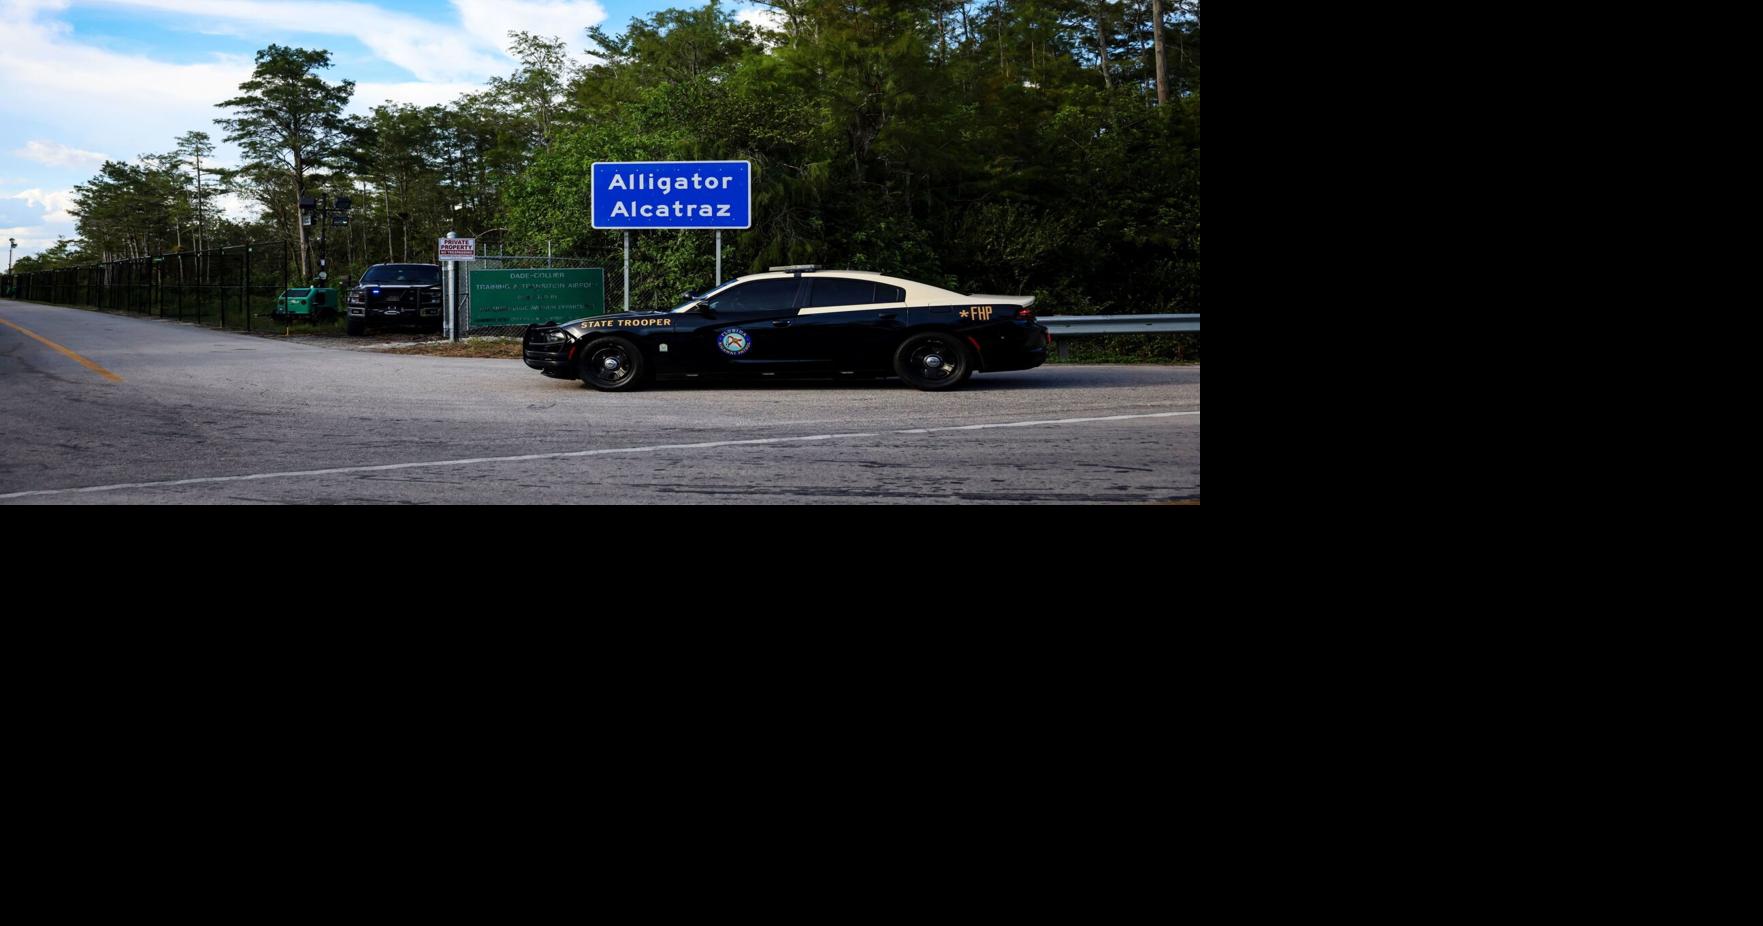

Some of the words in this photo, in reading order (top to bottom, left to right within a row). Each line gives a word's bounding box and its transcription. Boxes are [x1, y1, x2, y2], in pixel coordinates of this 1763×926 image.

[608, 173, 733, 195] Alligator
[610, 200, 731, 217] Alcatraz
[970, 306, 993, 321] FHP
[581, 319, 614, 329] STATE
[617, 318, 671, 327] TROOPER
